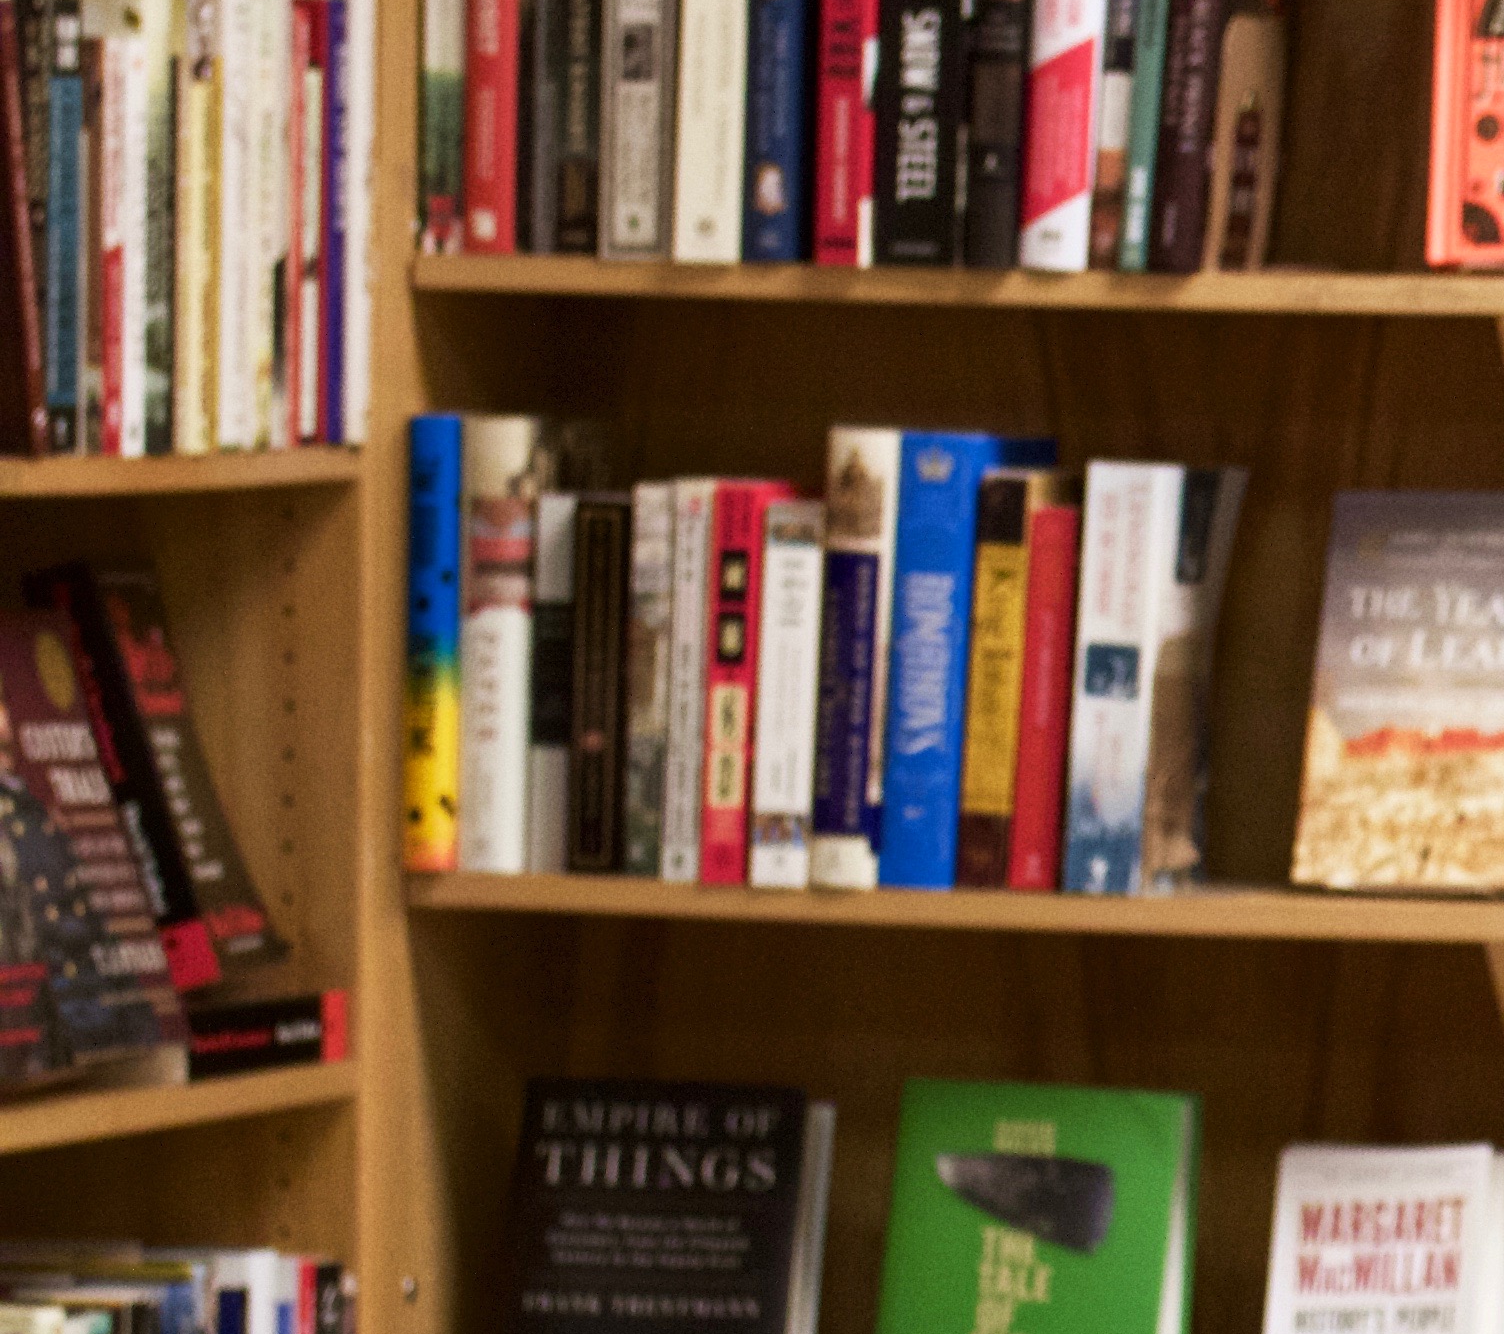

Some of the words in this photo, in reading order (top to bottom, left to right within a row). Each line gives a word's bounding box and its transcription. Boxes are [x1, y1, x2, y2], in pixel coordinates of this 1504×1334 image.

[897, 115, 939, 201] STEEL
[1350, 585, 1416, 623] THE
[1350, 632, 1394, 665] OF
[542, 1100, 709, 1140] EMPIRE
[724, 1106, 780, 1140] OF
[535, 1141, 778, 1192] THINGS
[1299, 1196, 1467, 1243] MARGARET
